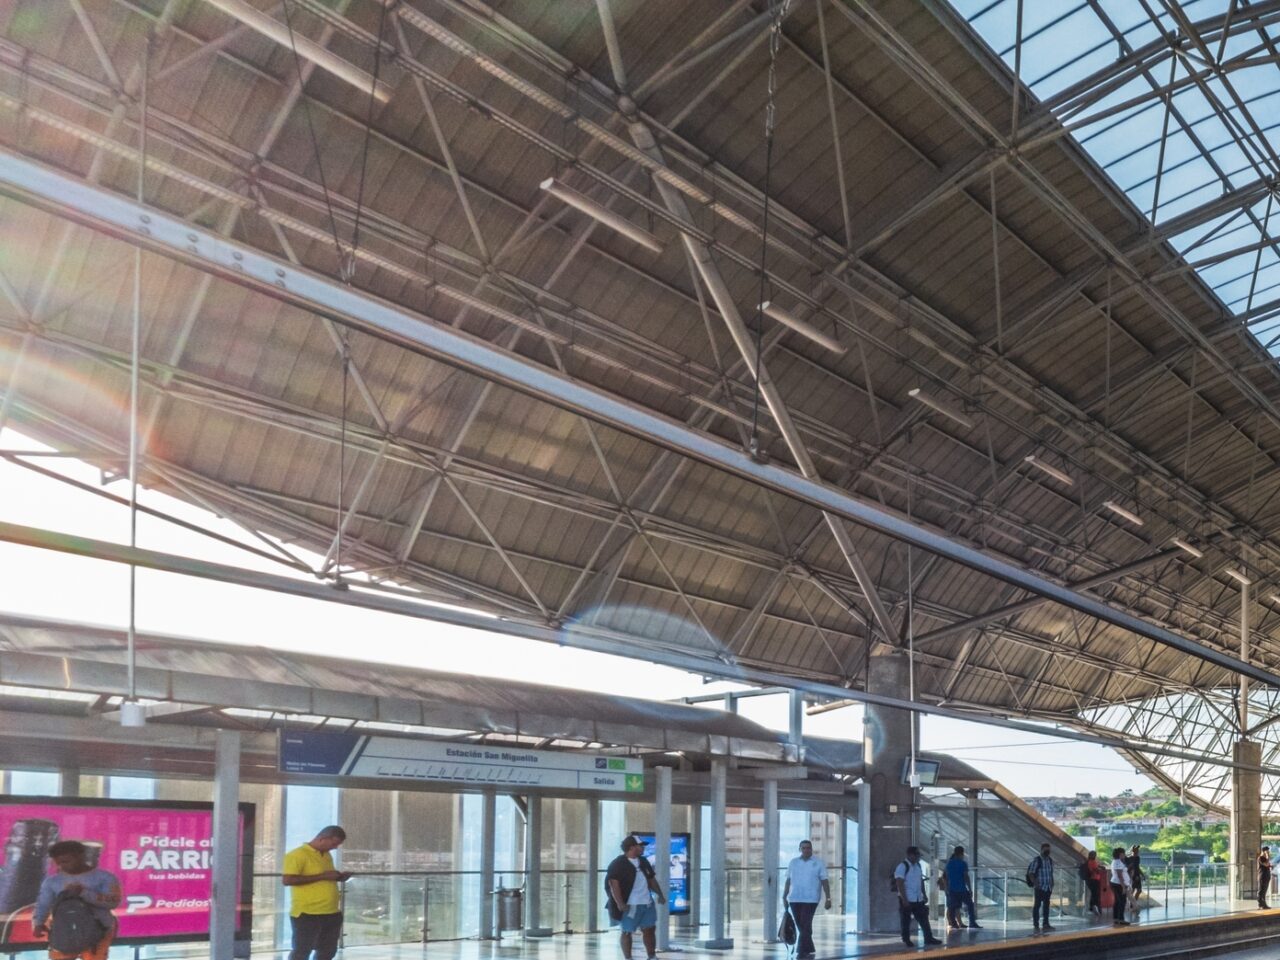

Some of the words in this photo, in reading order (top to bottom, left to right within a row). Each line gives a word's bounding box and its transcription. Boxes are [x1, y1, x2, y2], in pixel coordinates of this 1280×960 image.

[446, 748, 482, 759] Estación
[484, 751, 499, 759] San
[501, 752, 538, 763] Miguelito
[140, 835, 196, 848] Pídele
[120, 849, 214, 870] BARRI
[155, 898, 213, 909] Pedidos
